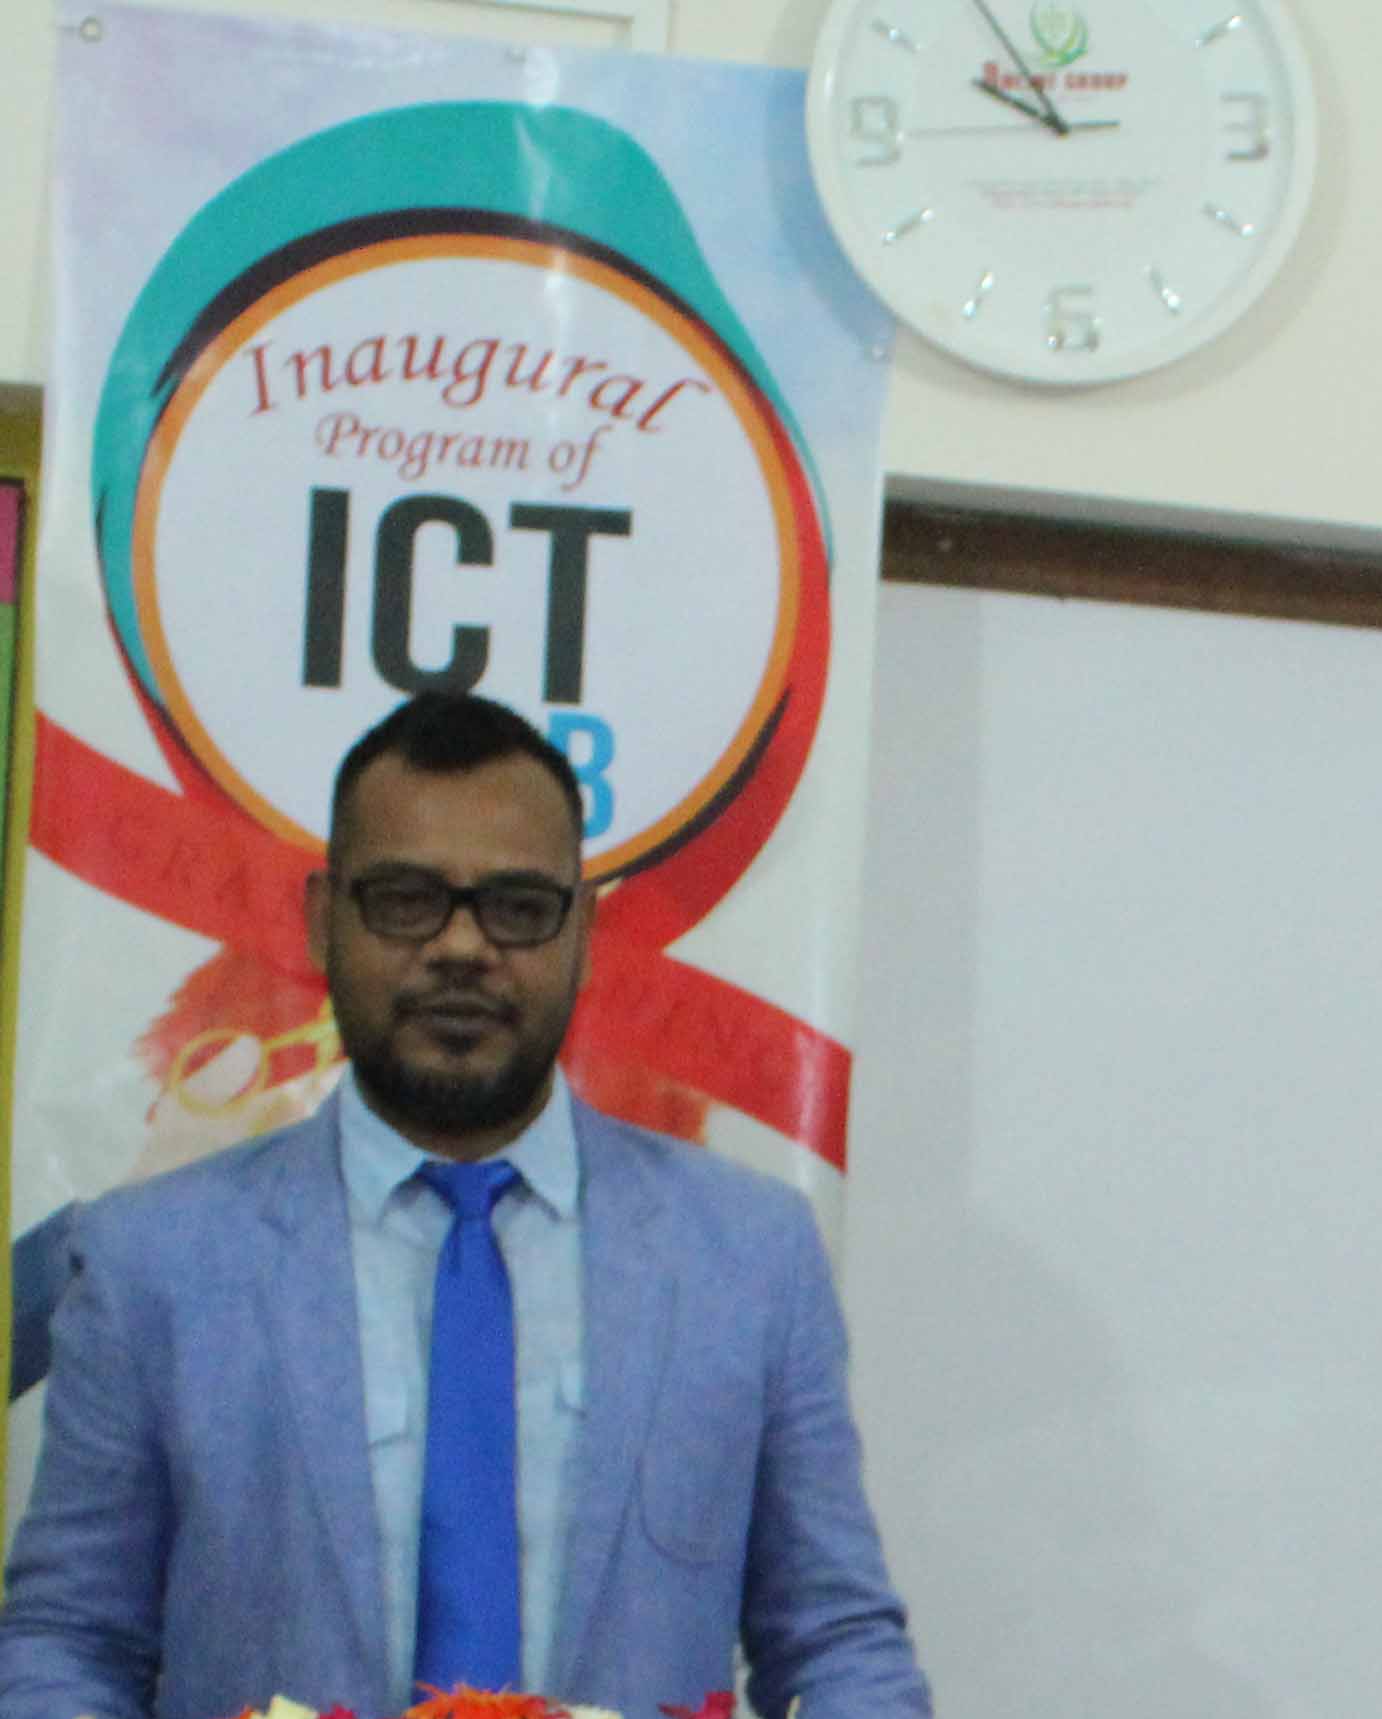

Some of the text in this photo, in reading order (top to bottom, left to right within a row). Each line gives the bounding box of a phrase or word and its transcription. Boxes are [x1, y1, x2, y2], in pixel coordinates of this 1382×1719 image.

[242, 334, 713, 434] Inaugural
[314, 411, 616, 493] Program of
[302, 485, 634, 706] ICT
